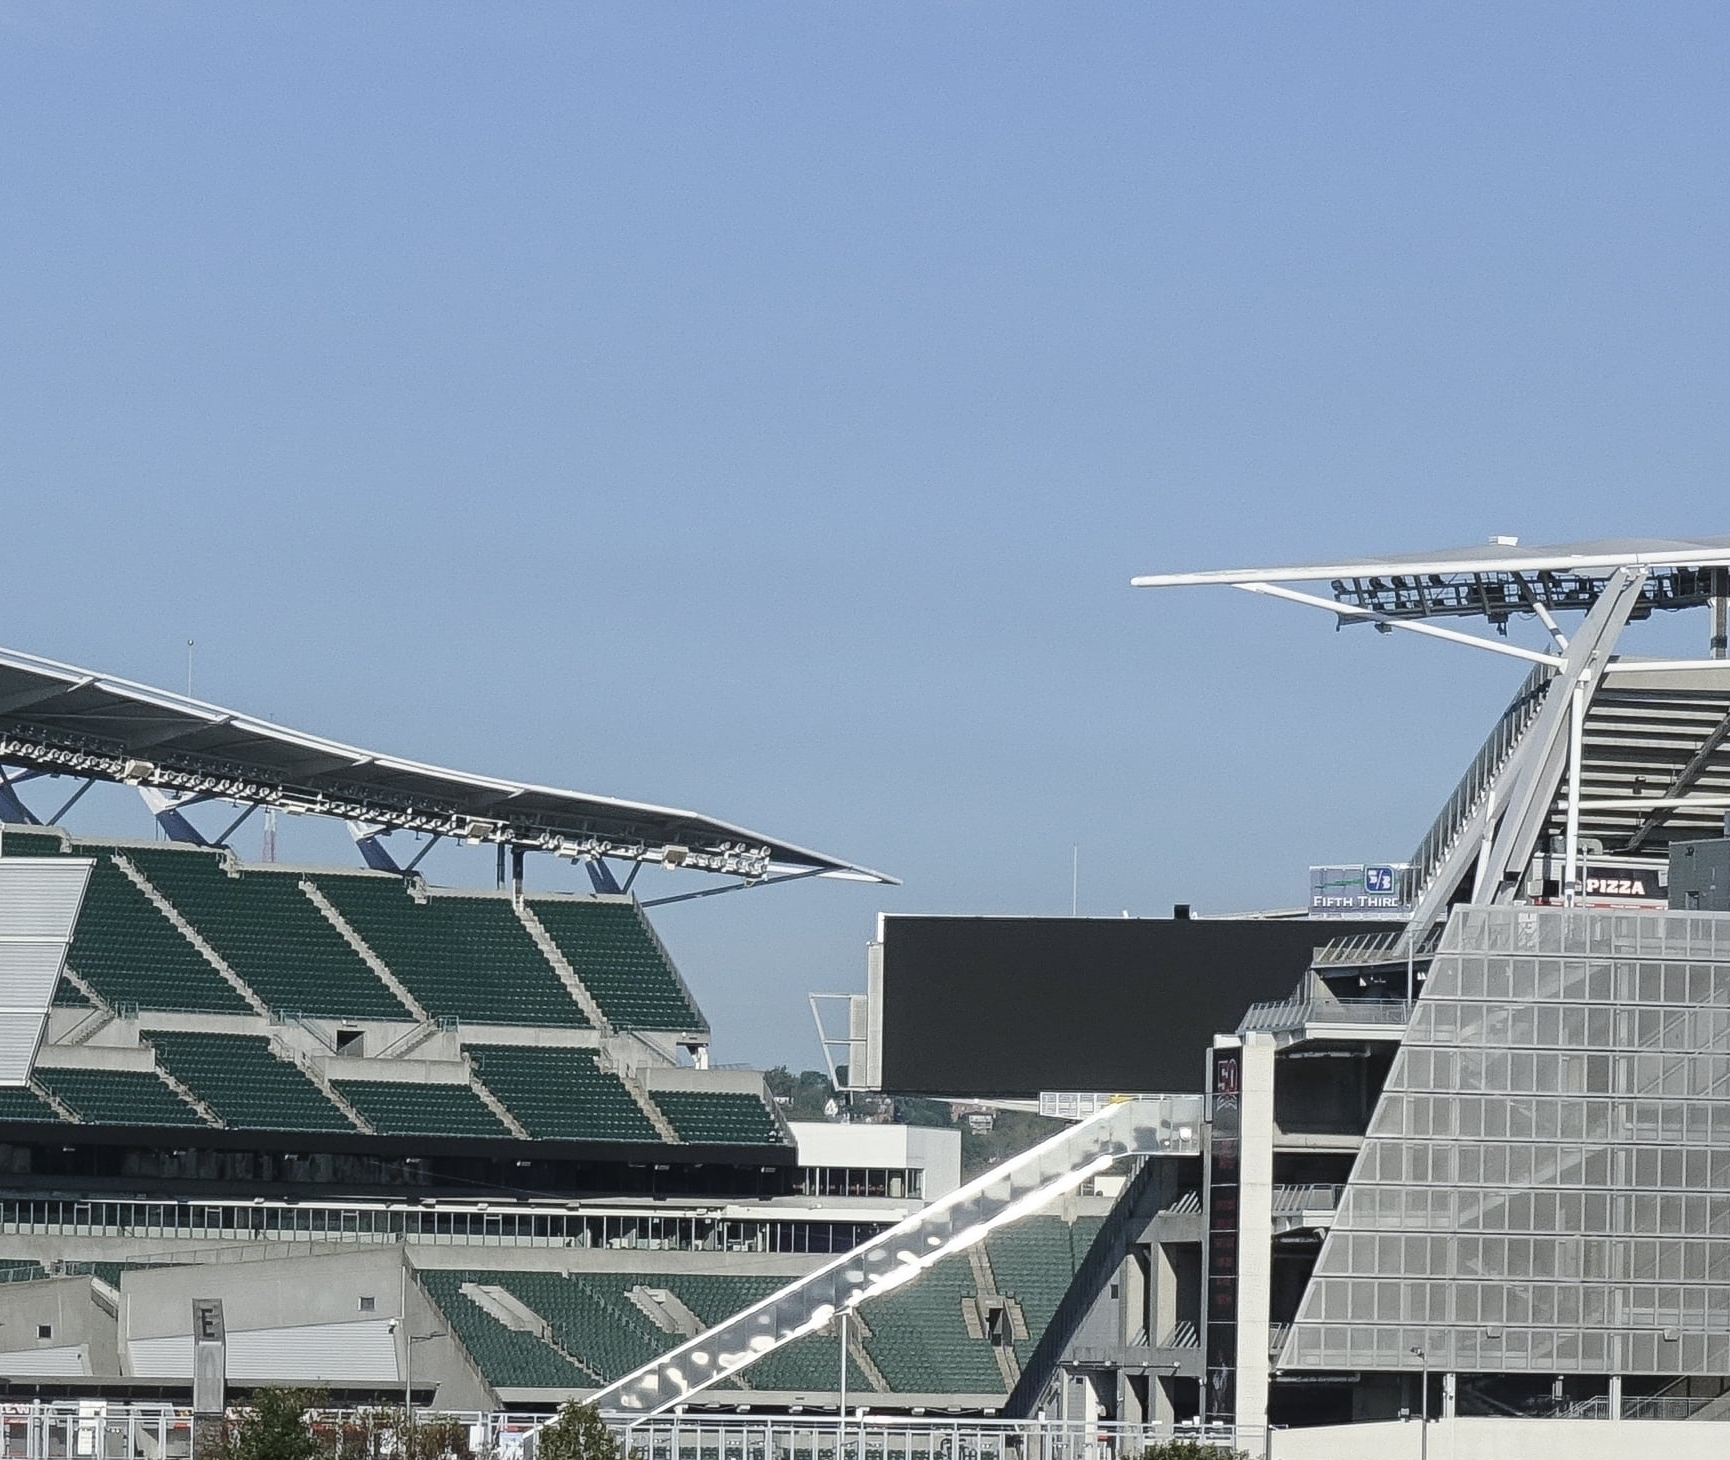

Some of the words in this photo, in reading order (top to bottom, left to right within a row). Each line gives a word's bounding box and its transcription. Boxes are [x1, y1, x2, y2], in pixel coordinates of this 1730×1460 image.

[1586, 879, 1645, 895] PIZZA
[1313, 895, 1353, 907] FIFTH
[201, 1308, 215, 1338] E
